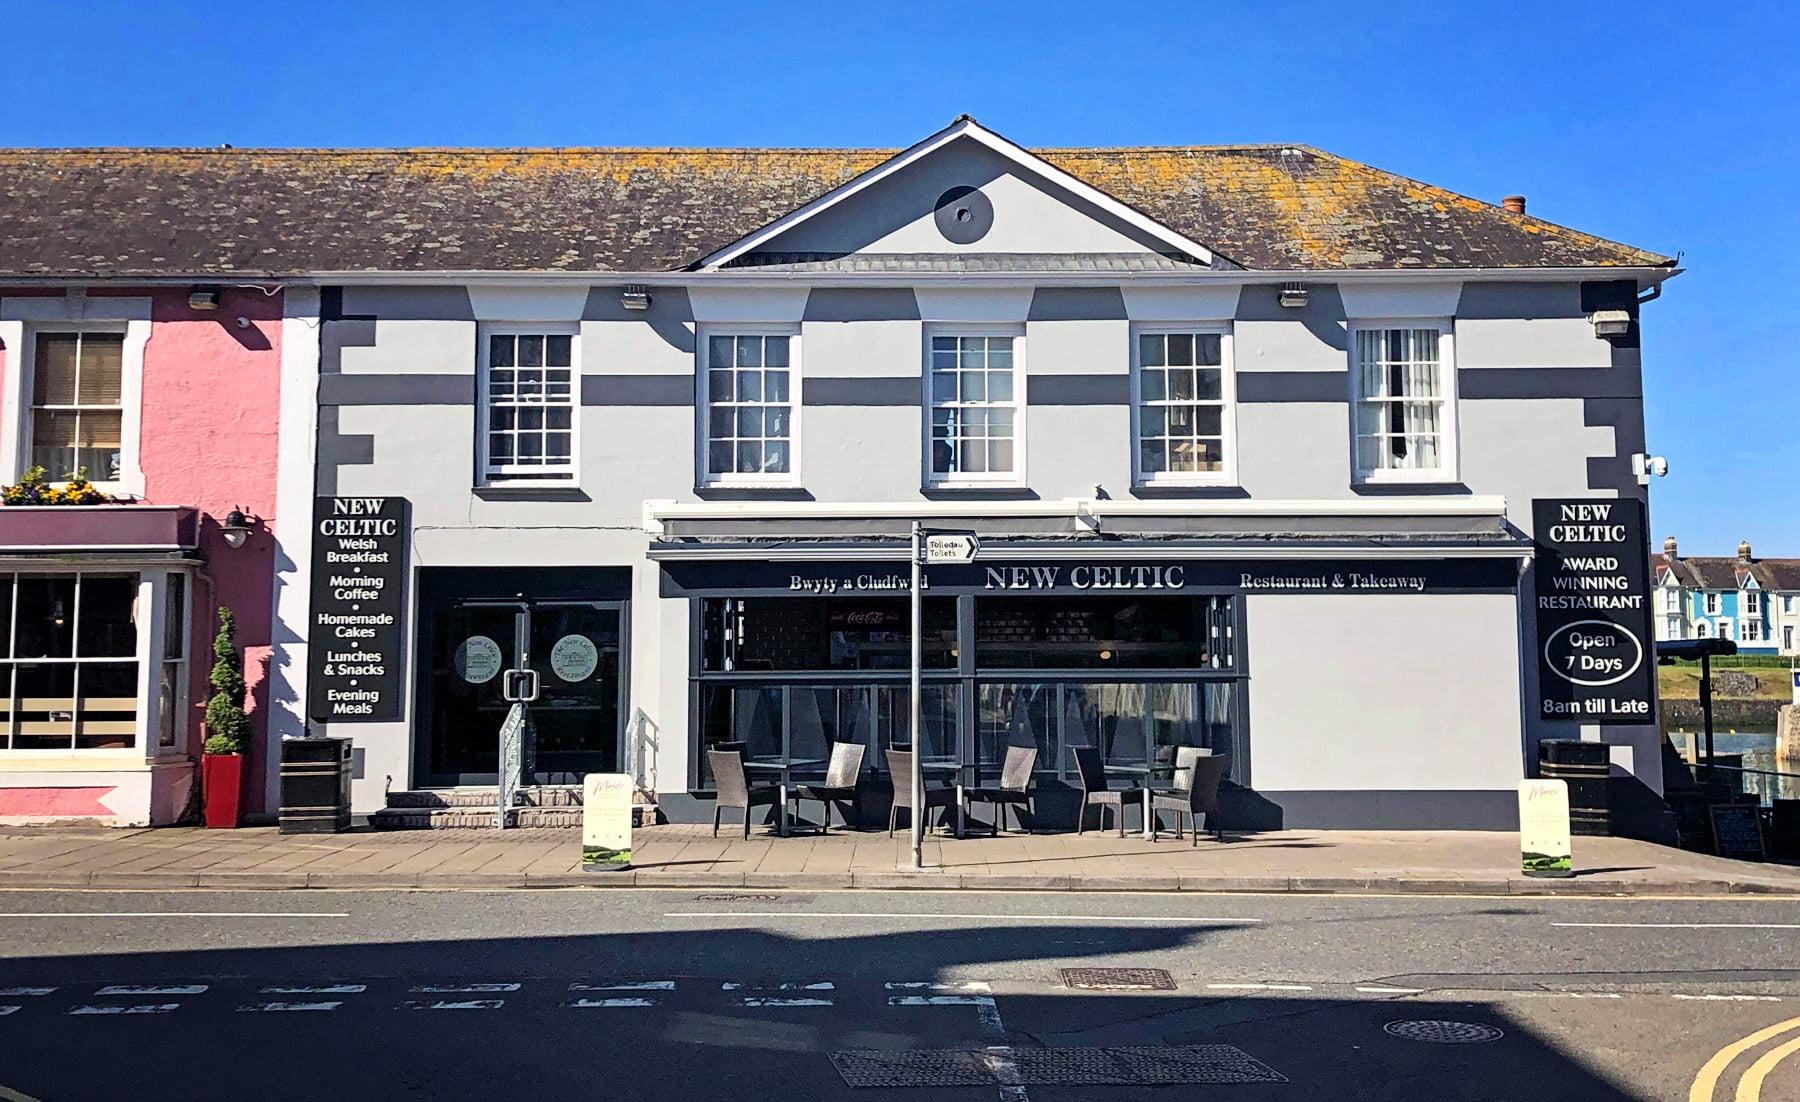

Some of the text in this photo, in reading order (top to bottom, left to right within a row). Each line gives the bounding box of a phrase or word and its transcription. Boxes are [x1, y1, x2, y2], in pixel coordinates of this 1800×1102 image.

[333, 499, 385, 515] NEW
[1561, 505, 1612, 521] NEW
[320, 519, 397, 536] CELTIC
[1549, 525, 1626, 542] CELTIC
[338, 539, 378, 550] Welsh
[326, 551, 389, 563] Breakfast
[1561, 557, 1618, 571] AWARD
[329, 575, 384, 588] Morning
[789, 574, 929, 592] Bwyty a Cludfwd
[984, 565, 1184, 589] NEW CELTIC
[1239, 573, 1427, 591] Restaurant & Takeaway
[1553, 576, 1628, 590] WINNING
[334, 588, 379, 600] Coffee
[1539, 595, 1643, 609] RESTAURANT
[318, 613, 393, 625] Homemade
[335, 626, 376, 638] Cakes
[1569, 632, 1616, 650] Open
[327, 650, 382, 662] Lunches
[323, 664, 385, 676] & Snacks
[1565, 655, 1623, 673] 7 Days
[327, 689, 379, 703] Evening
[333, 702, 373, 714] Meals
[1543, 699, 1649, 714] 8am till Late
